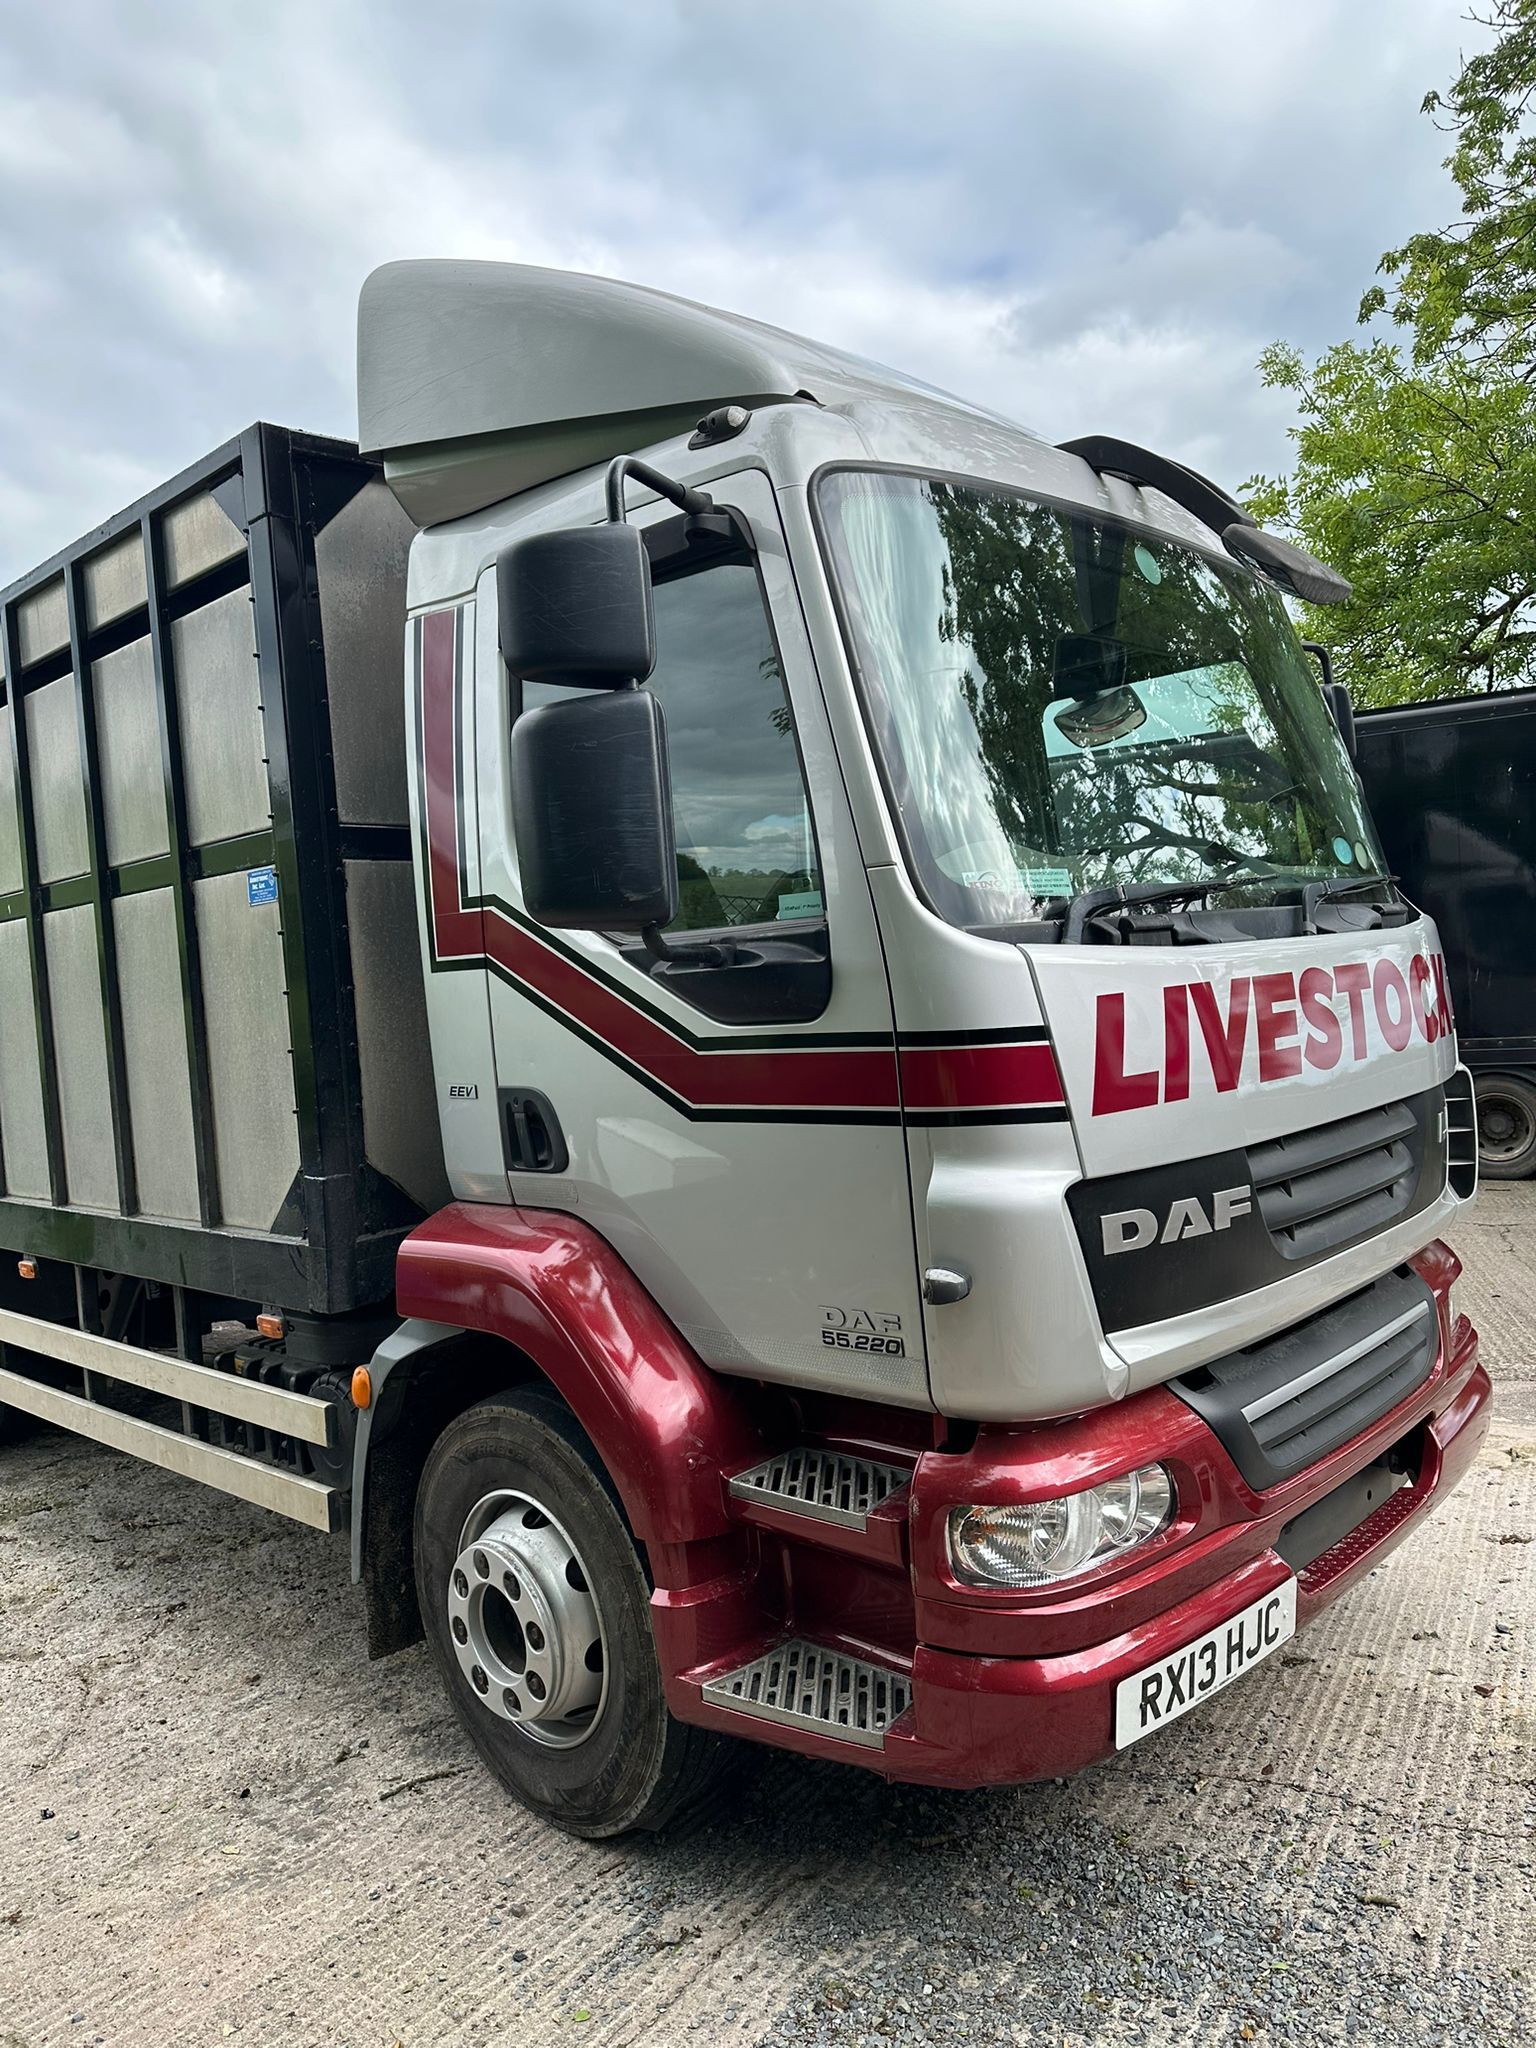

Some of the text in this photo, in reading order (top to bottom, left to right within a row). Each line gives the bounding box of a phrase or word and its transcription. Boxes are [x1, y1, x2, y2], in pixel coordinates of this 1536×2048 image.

[1092, 953, 1453, 1117] LIVESTOCK
[449, 1086, 474, 1098] EEV
[1100, 1184, 1251, 1256] DAF
[817, 1304, 902, 1333] DAF
[821, 1329, 902, 1355] 55.220
[1140, 1597, 1280, 1728] RX13 HJC
